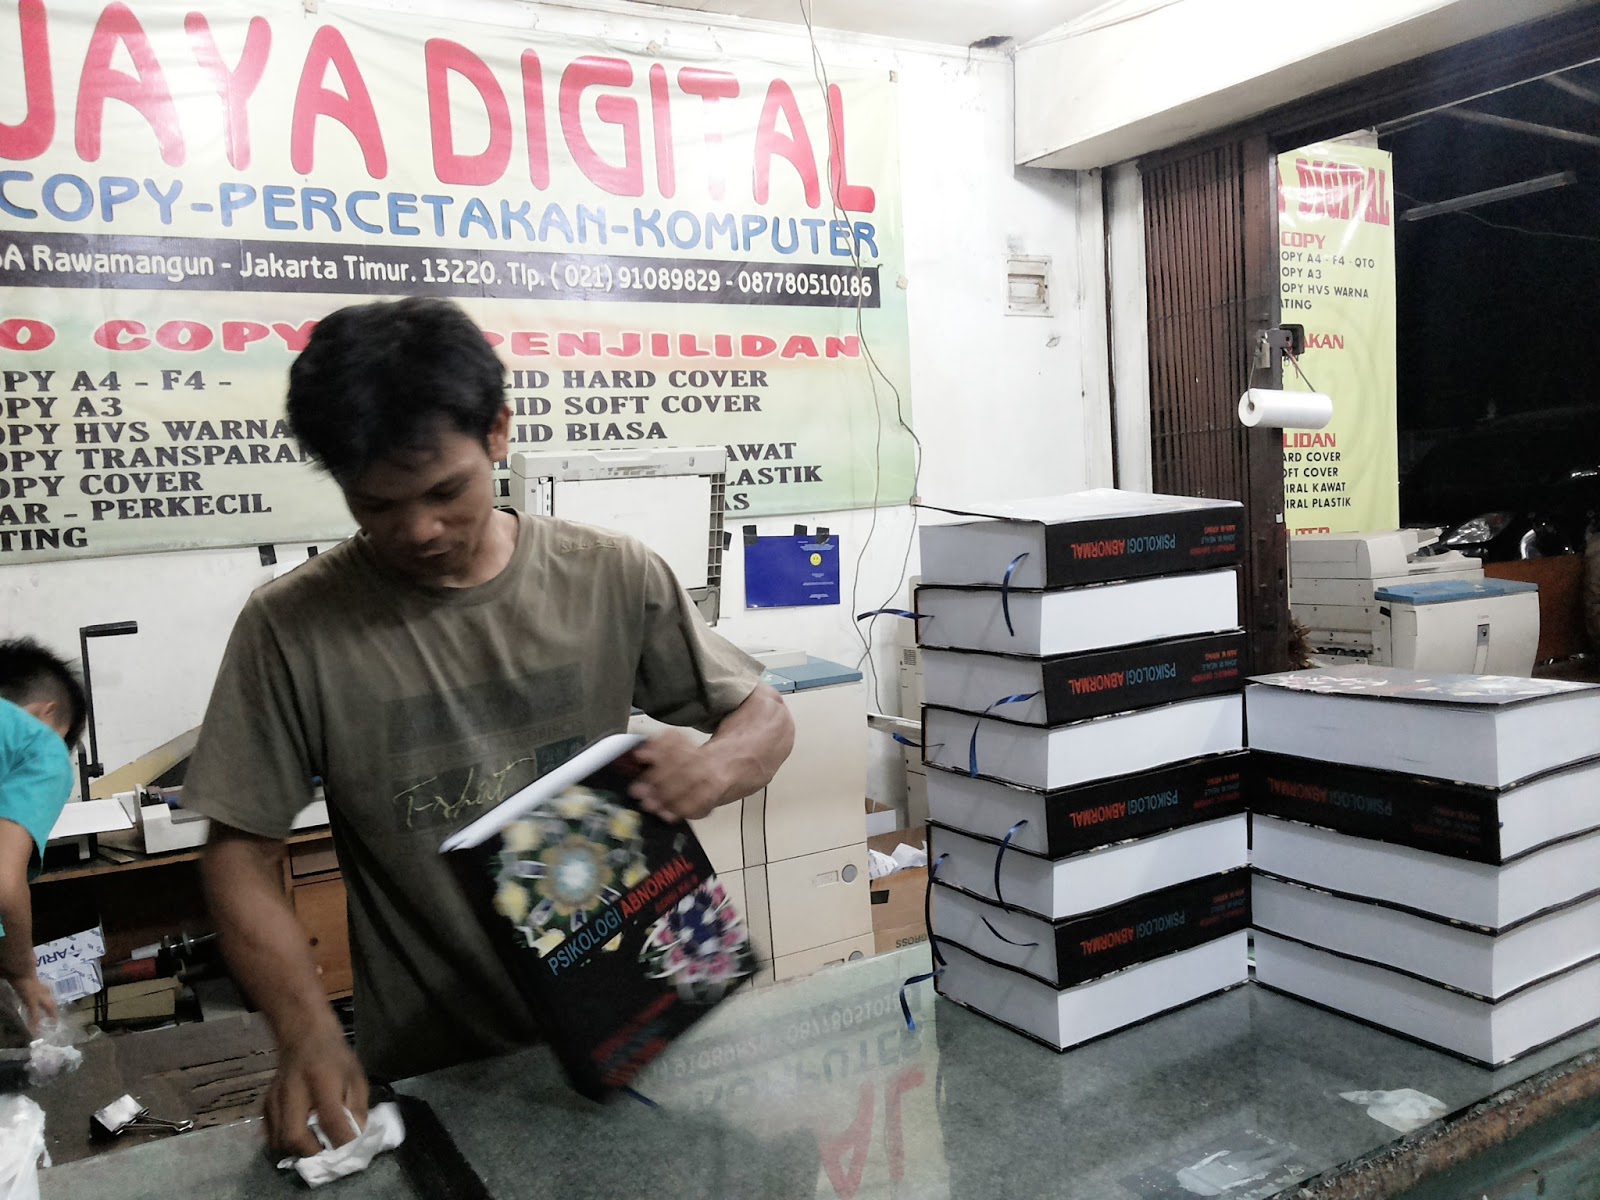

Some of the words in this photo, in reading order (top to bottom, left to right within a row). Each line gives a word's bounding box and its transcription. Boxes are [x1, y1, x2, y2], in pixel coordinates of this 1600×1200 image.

[0, 0, 388, 180] JAYA
[425, 38, 876, 214] DIGITAL
[1295, 158, 1391, 227] DIGITAL
[1281, 231, 1326, 250] COPY
[1281, 251, 1304, 264] OPY
[1307, 253, 1323, 265] A4
[1332, 254, 1346, 267] F4
[1354, 257, 1376, 269] QTO
[0, 244, 26, 272] A
[33, 246, 215, 283] Rawamangun
[240, 252, 338, 281] Jakarta
[343, 255, 416, 283] Timur.
[422, 259, 502, 286] 13220.
[619, 268, 721, 293] 91089829
[738, 271, 874, 299] 087780510186
[1281, 266, 1304, 279] OPY
[1307, 268, 1323, 280] A3
[1281, 283, 1305, 294] OPY
[1307, 284, 1331, 296] HVS
[1333, 286, 1370, 299] WARNA
[0, 370, 57, 392] PY
[71, 369, 122, 392] A4
[161, 369, 206, 391] F4
[562, 370, 656, 389] HARD
[669, 370, 769, 388] COVER
[0, 396, 59, 419] PY
[73, 396, 123, 418] A3
[564, 396, 650, 416] SOFT
[661, 394, 762, 414] COVER
[74, 421, 151, 444] HVS
[162, 418, 295, 442] WARNA
[566, 421, 668, 442] BIASA
[1282, 432, 1337, 449] LIDAN
[725, 442, 797, 462] AWAT
[1306, 451, 1342, 463] COVER
[79, 471, 205, 496] COVER
[1303, 467, 1339, 478] COVER
[1284, 483, 1309, 494] IRAL
[1312, 482, 1347, 494] KAWAT
[92, 493, 273, 521] PERKECIL
[1284, 498, 1309, 510] IRAL
[1312, 497, 1352, 509] PLASTIK
[1071, 539, 1125, 560] ABNORMAL
[1127, 533, 1176, 554] PSIKOLOGI
[1067, 671, 1125, 695] ABNORMAL
[1126, 662, 1177, 686] PSIKOLOGI
[1127, 788, 1179, 815] PSIKOLOGI
[1069, 802, 1127, 829] ABNORMAL
[547, 907, 623, 977] PSIKOLOGI
[620, 854, 695, 919] ABNORMAL
[1135, 909, 1186, 939] PSIKOLOGI
[1079, 927, 1134, 955] ABNORMAL
